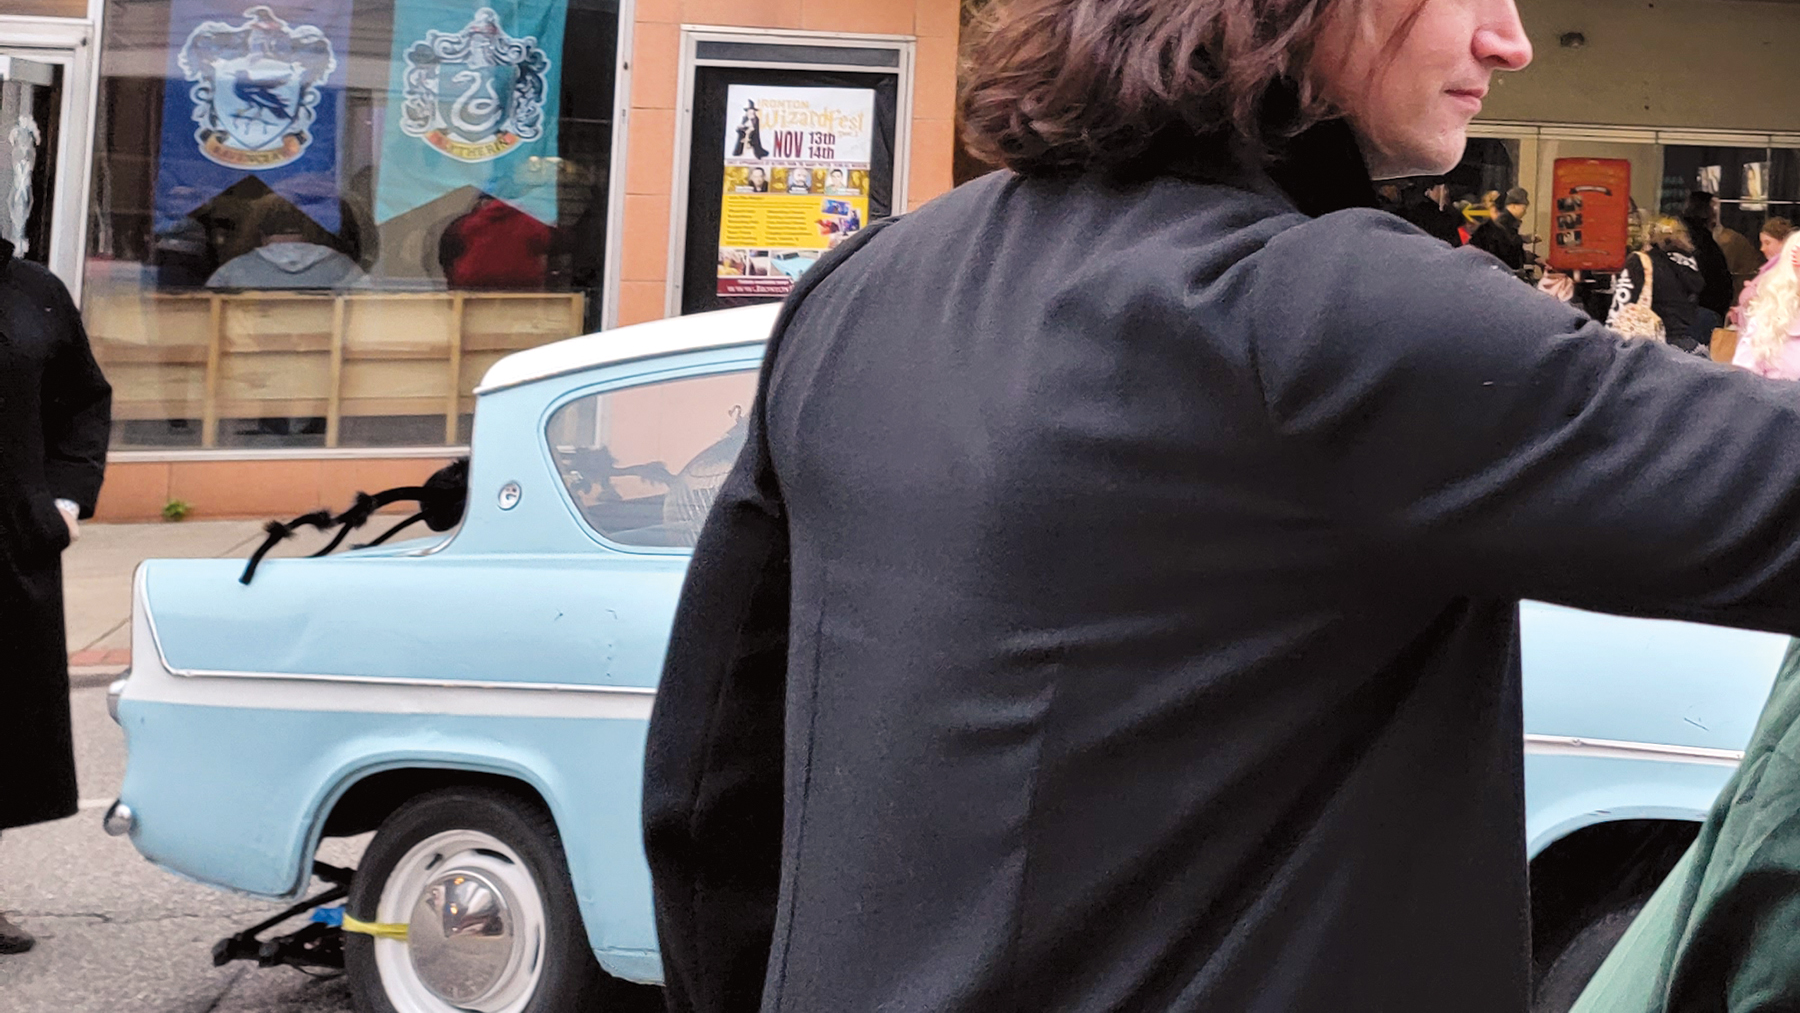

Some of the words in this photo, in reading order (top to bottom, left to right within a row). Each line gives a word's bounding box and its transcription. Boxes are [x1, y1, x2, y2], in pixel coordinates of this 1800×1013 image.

[773, 130, 803, 158] NOV
[808, 131, 836, 145] 13th
[807, 146, 835, 159] 14th
